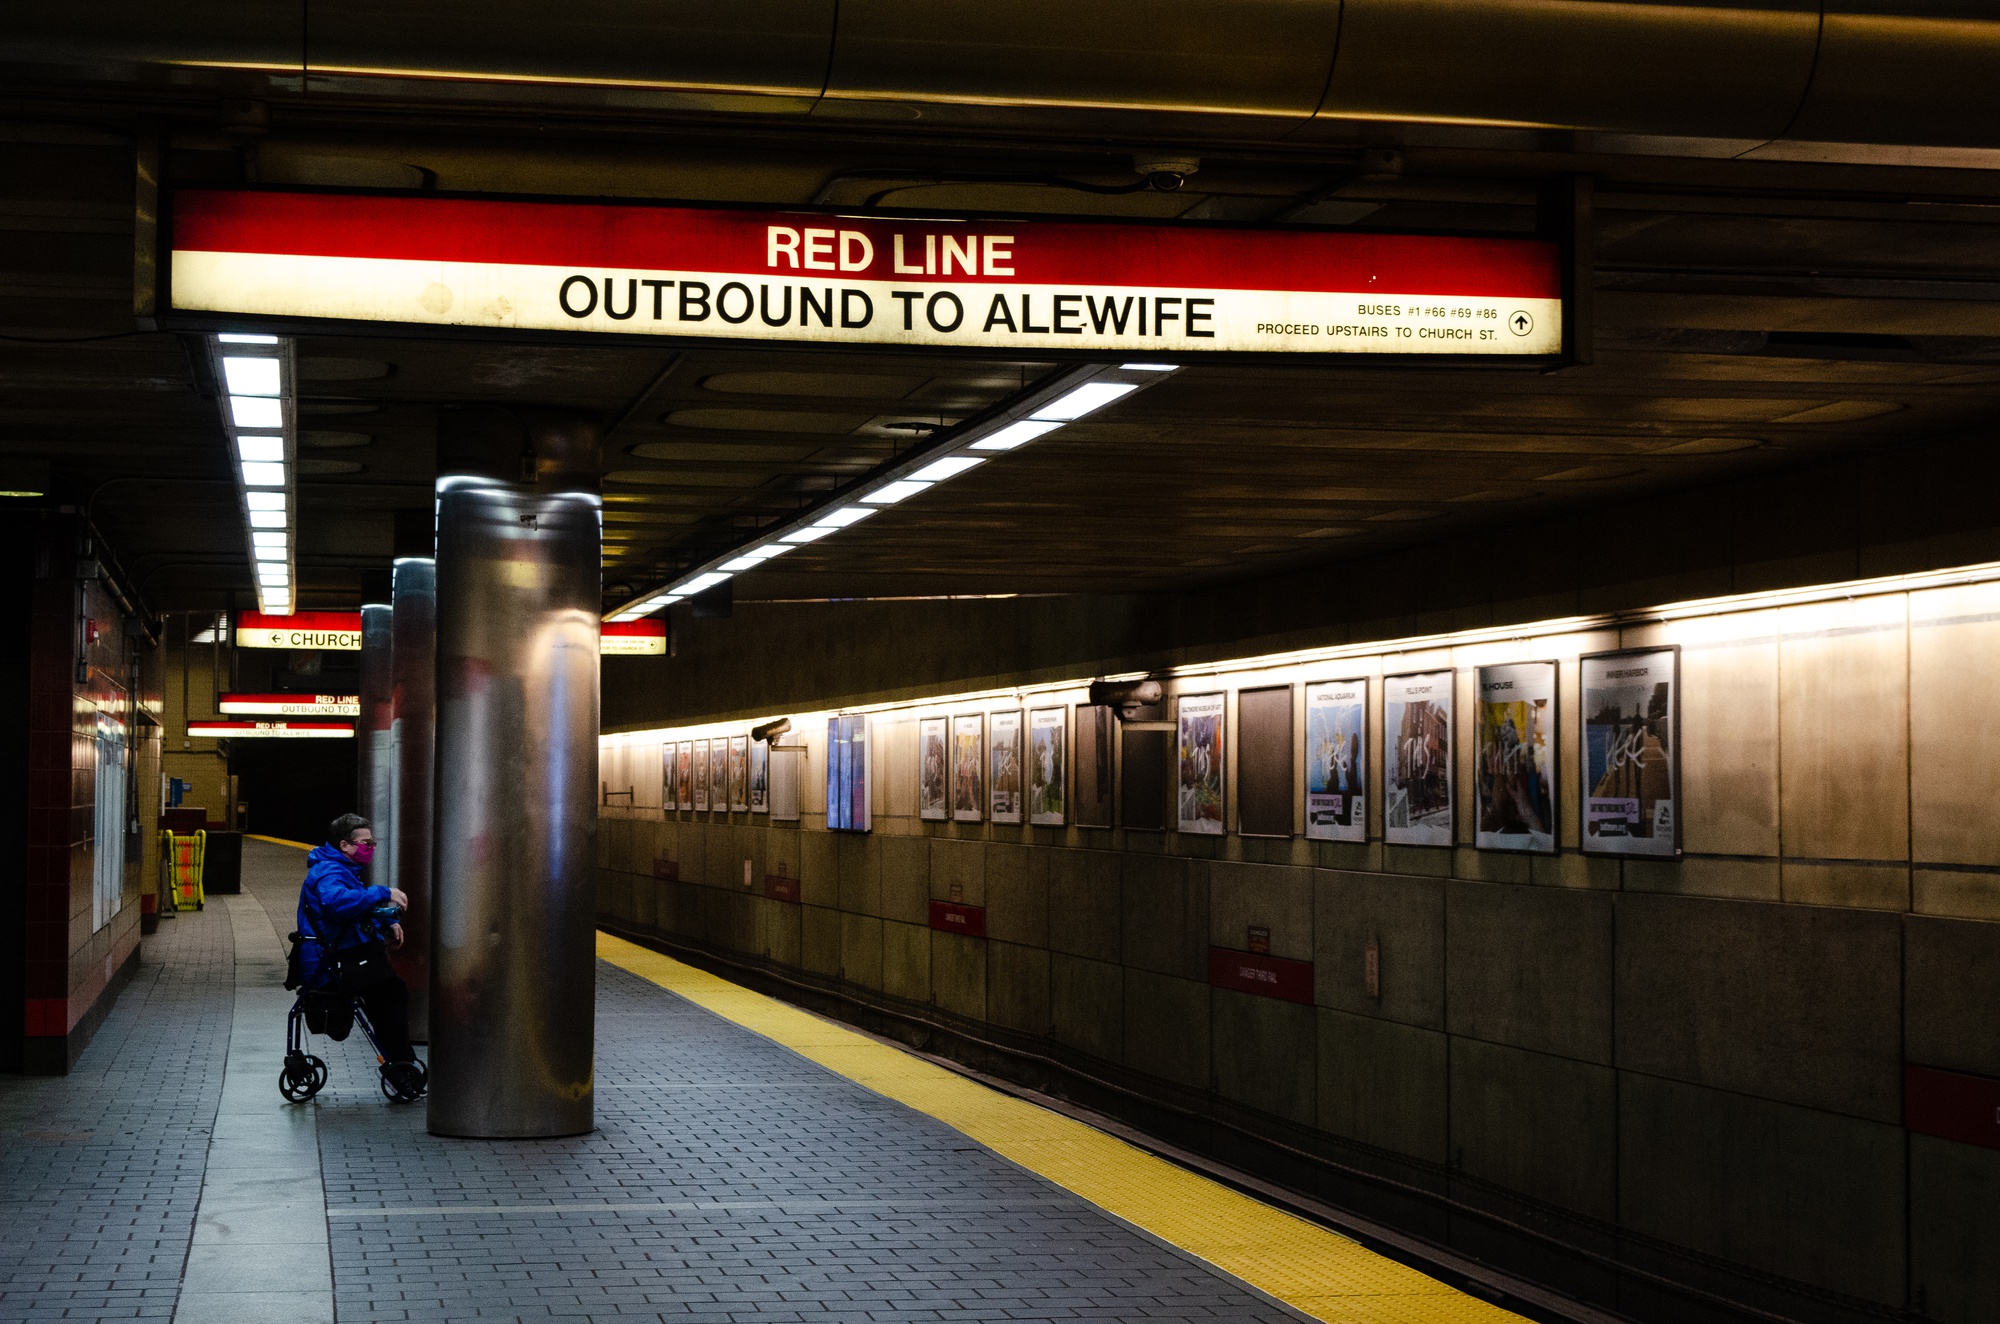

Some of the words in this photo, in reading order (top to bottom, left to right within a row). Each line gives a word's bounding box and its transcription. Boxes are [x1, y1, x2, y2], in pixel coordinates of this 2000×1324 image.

[767, 225, 874, 272] RED
[893, 233, 1015, 277] LINE
[558, 274, 874, 329] OUTBOUND
[891, 290, 964, 333] TO
[982, 293, 1215, 338] ALEWIFE
[1358, 304, 1401, 316] BUSES
[1408, 306, 1420, 317] #1
[1425, 307, 1446, 318] #66
[1450, 307, 1472, 319] #69
[1476, 308, 1498, 320] #86
[1257, 323, 1320, 336] PROCEED
[1326, 325, 1389, 338] UPSTAIRS
[1395, 327, 1412, 338] TO
[1419, 327, 1473, 340] CHURCH
[1479, 329, 1498, 341] ST.
[290, 632, 361, 647] CHURCH
[1489, 680, 1514, 691] HOUSE
[315, 695, 336, 704] RED
[337, 695, 359, 704] LINE
[281, 705, 335, 713] OUTBOUND
[256, 722, 270, 730] RED
[271, 722, 287, 730] LINE
